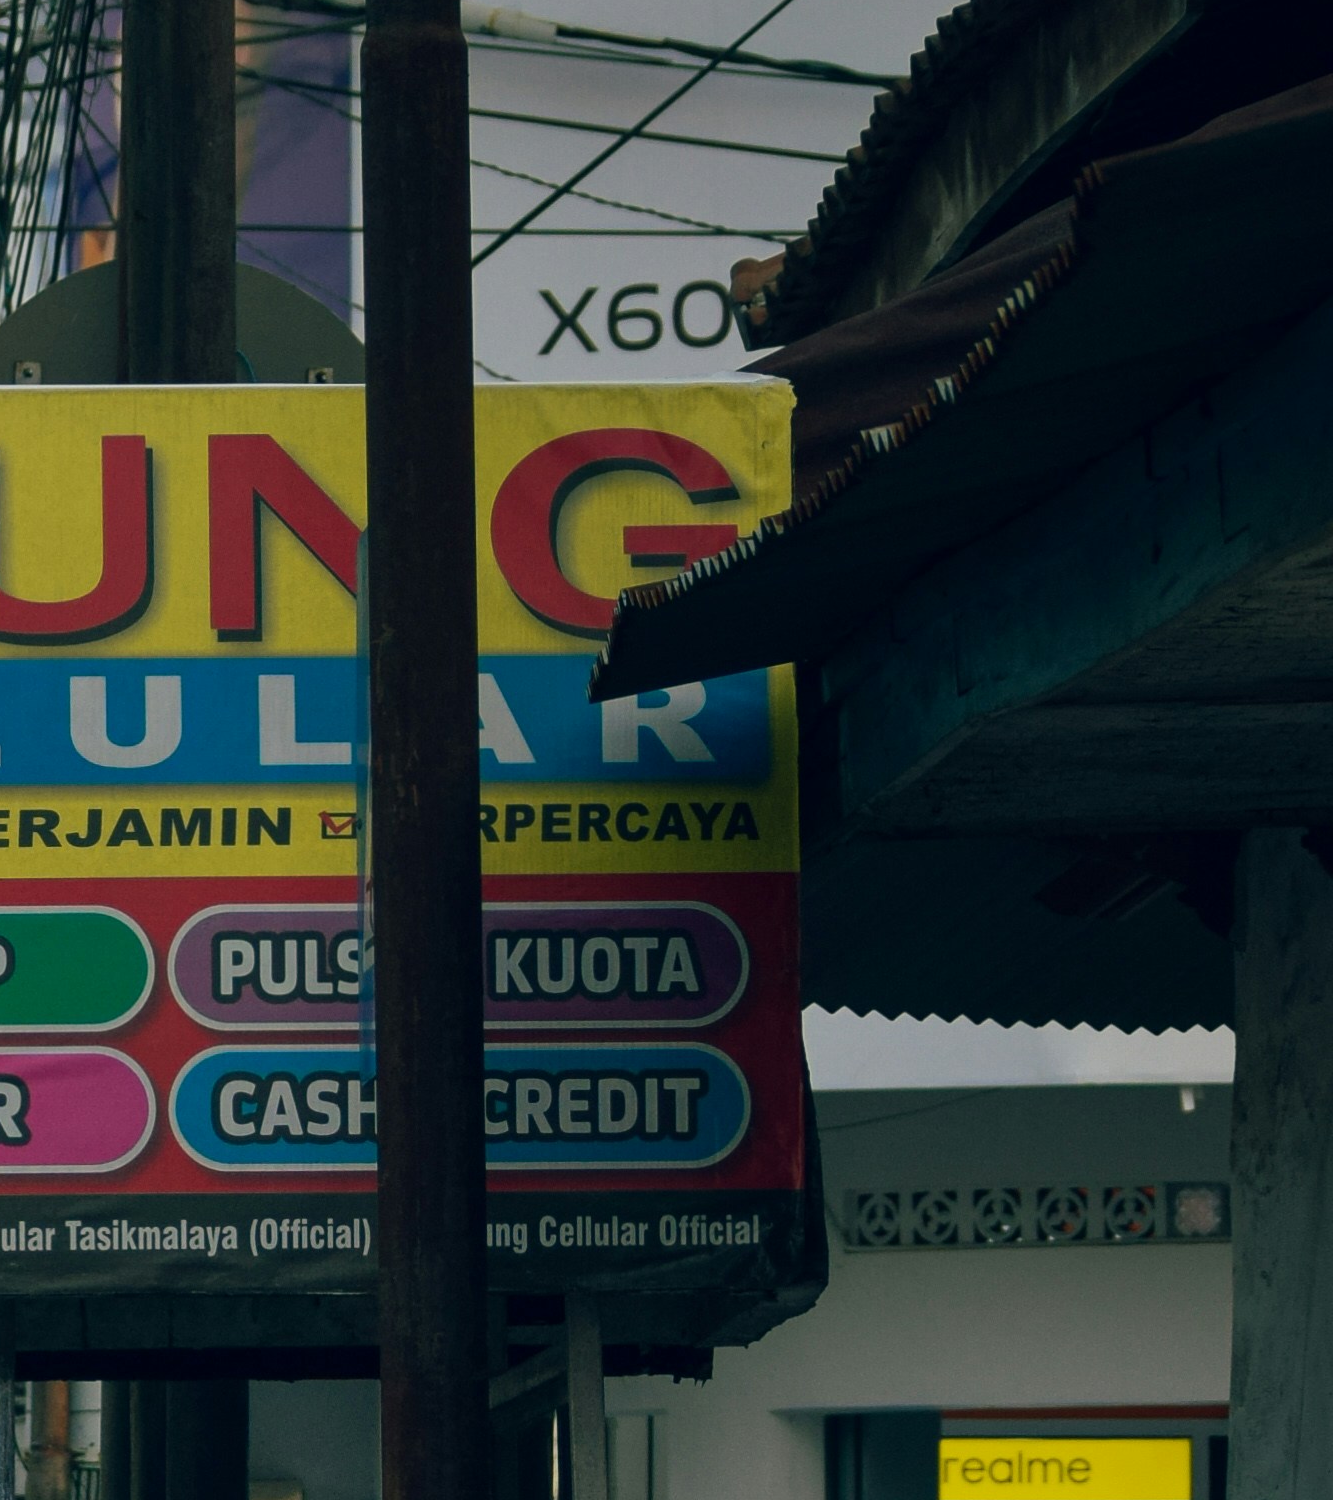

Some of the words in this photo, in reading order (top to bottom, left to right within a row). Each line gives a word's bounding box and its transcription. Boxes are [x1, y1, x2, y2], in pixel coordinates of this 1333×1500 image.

[538, 280, 733, 355] X60
[480, 802, 760, 843] RPERCAYA
[220, 938, 374, 995] PULS
[495, 937, 698, 993] KUOTA
[484, 1077, 700, 1134] CREDIT
[66, 1219, 237, 1256] Tasikmalaya
[249, 1218, 372, 1257] (Official)
[539, 1215, 649, 1248] Cellular
[660, 1214, 760, 1245] Official
[943, 1451, 1091, 1483] realme
